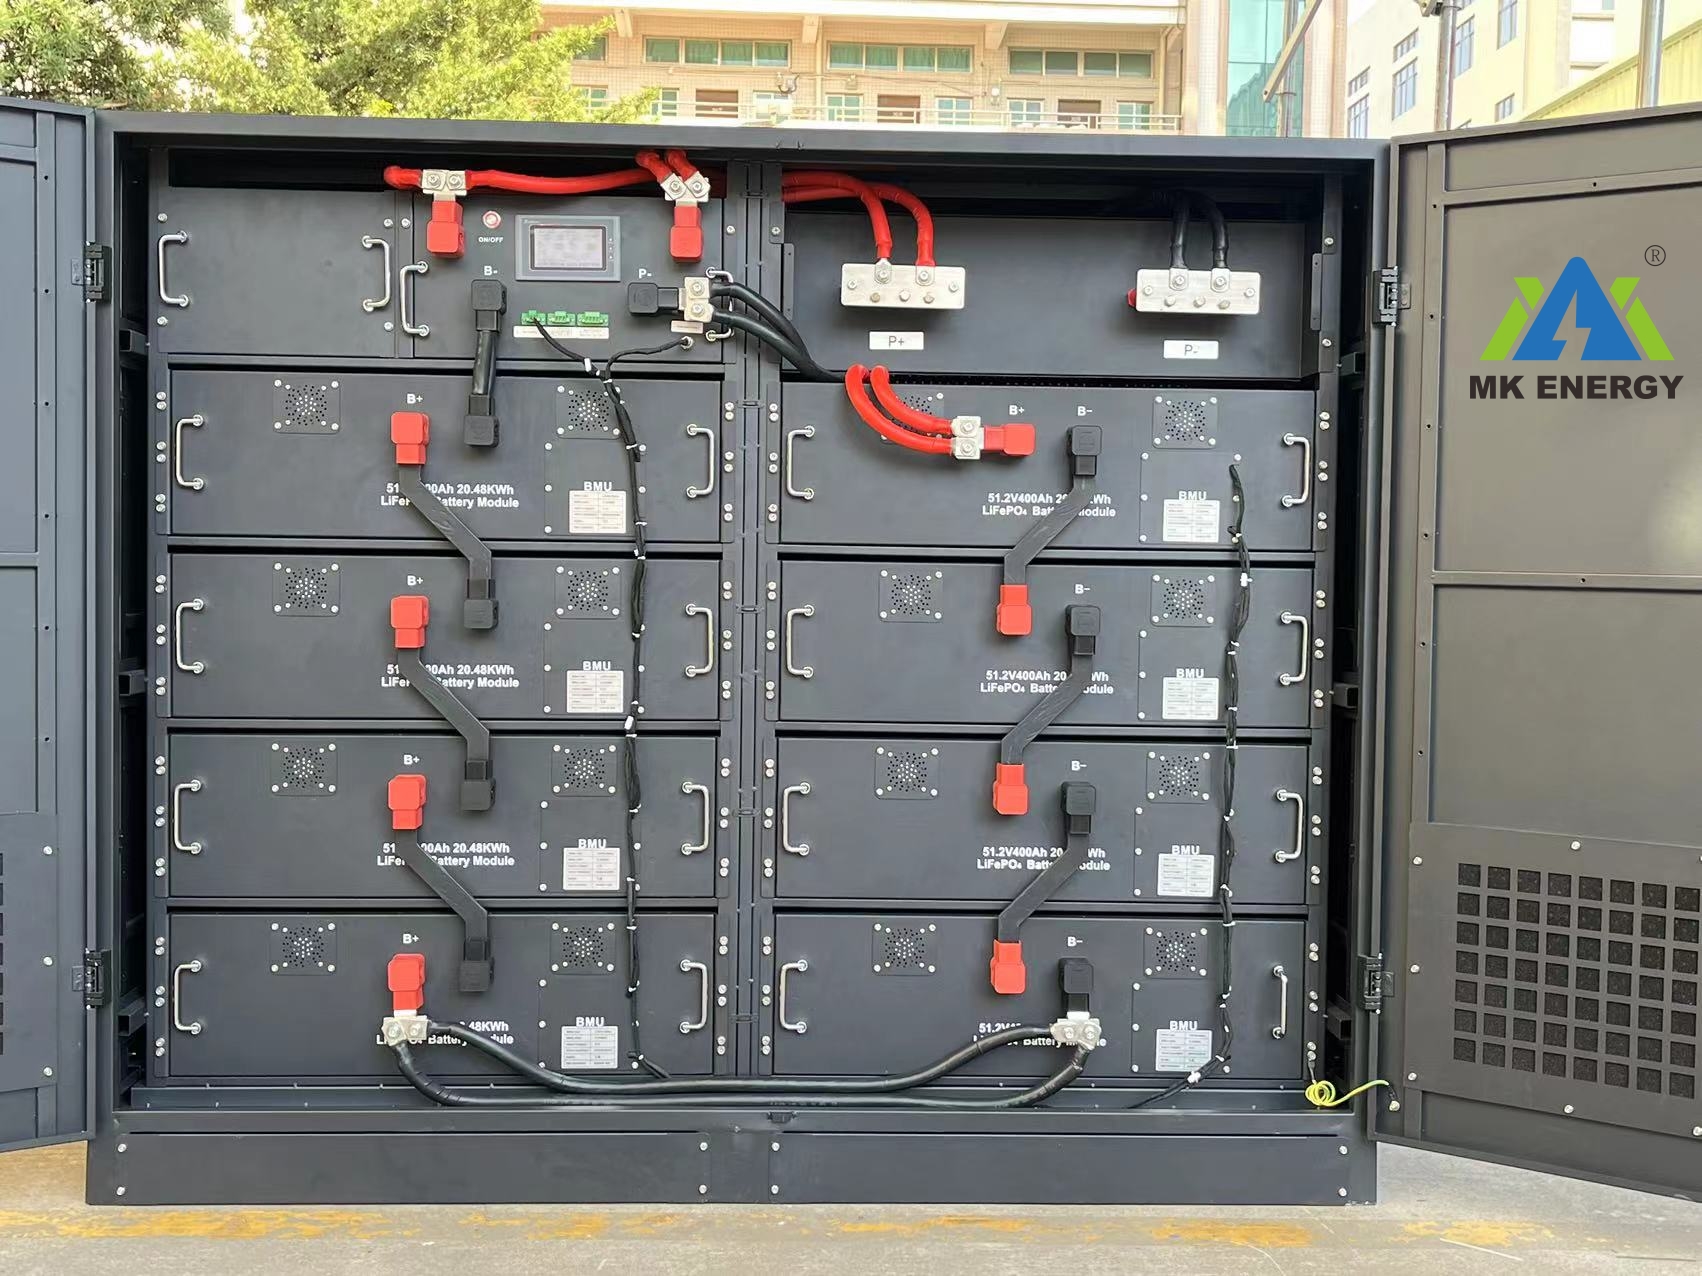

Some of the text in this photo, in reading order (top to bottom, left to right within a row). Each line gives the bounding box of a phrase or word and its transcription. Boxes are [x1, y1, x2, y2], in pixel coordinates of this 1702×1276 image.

[484, 265, 498, 276] B-
[638, 268, 652, 279] P-
[888, 335, 905, 346] P+
[1184, 344, 1198, 355] P-
[406, 394, 423, 404] B+
[1009, 405, 1025, 415] B+
[1077, 406, 1093, 416] B-
[456, 484, 514, 495] 20.48KWh
[583, 481, 613, 491] BMU
[987, 493, 1053, 504] 51.2V400Ah
[1178, 491, 1207, 500] BMU
[437, 496, 475, 509] attery
[477, 497, 520, 508] Module
[406, 575, 424, 586] B+
[1074, 584, 1091, 595] B-
[456, 664, 515, 675] 20.48KWh
[582, 661, 612, 671] BMU
[985, 670, 1051, 681] 51.2V400Ah
[1176, 668, 1204, 678] BMU
[437, 677, 475, 689] attery
[477, 677, 520, 688] Module
[403, 754, 420, 765] B+
[1071, 761, 1088, 771] B-
[452, 843, 510, 854] 20.48KWh
[578, 839, 607, 849] BMU
[982, 847, 1048, 857] 51.2V400Ah
[1171, 845, 1200, 855] BMU
[472, 856, 515, 866] Module
[402, 933, 419, 944] B+
[1067, 937, 1083, 947] B-
[575, 1017, 605, 1027] BMU
[1169, 1021, 1198, 1031] BMU
